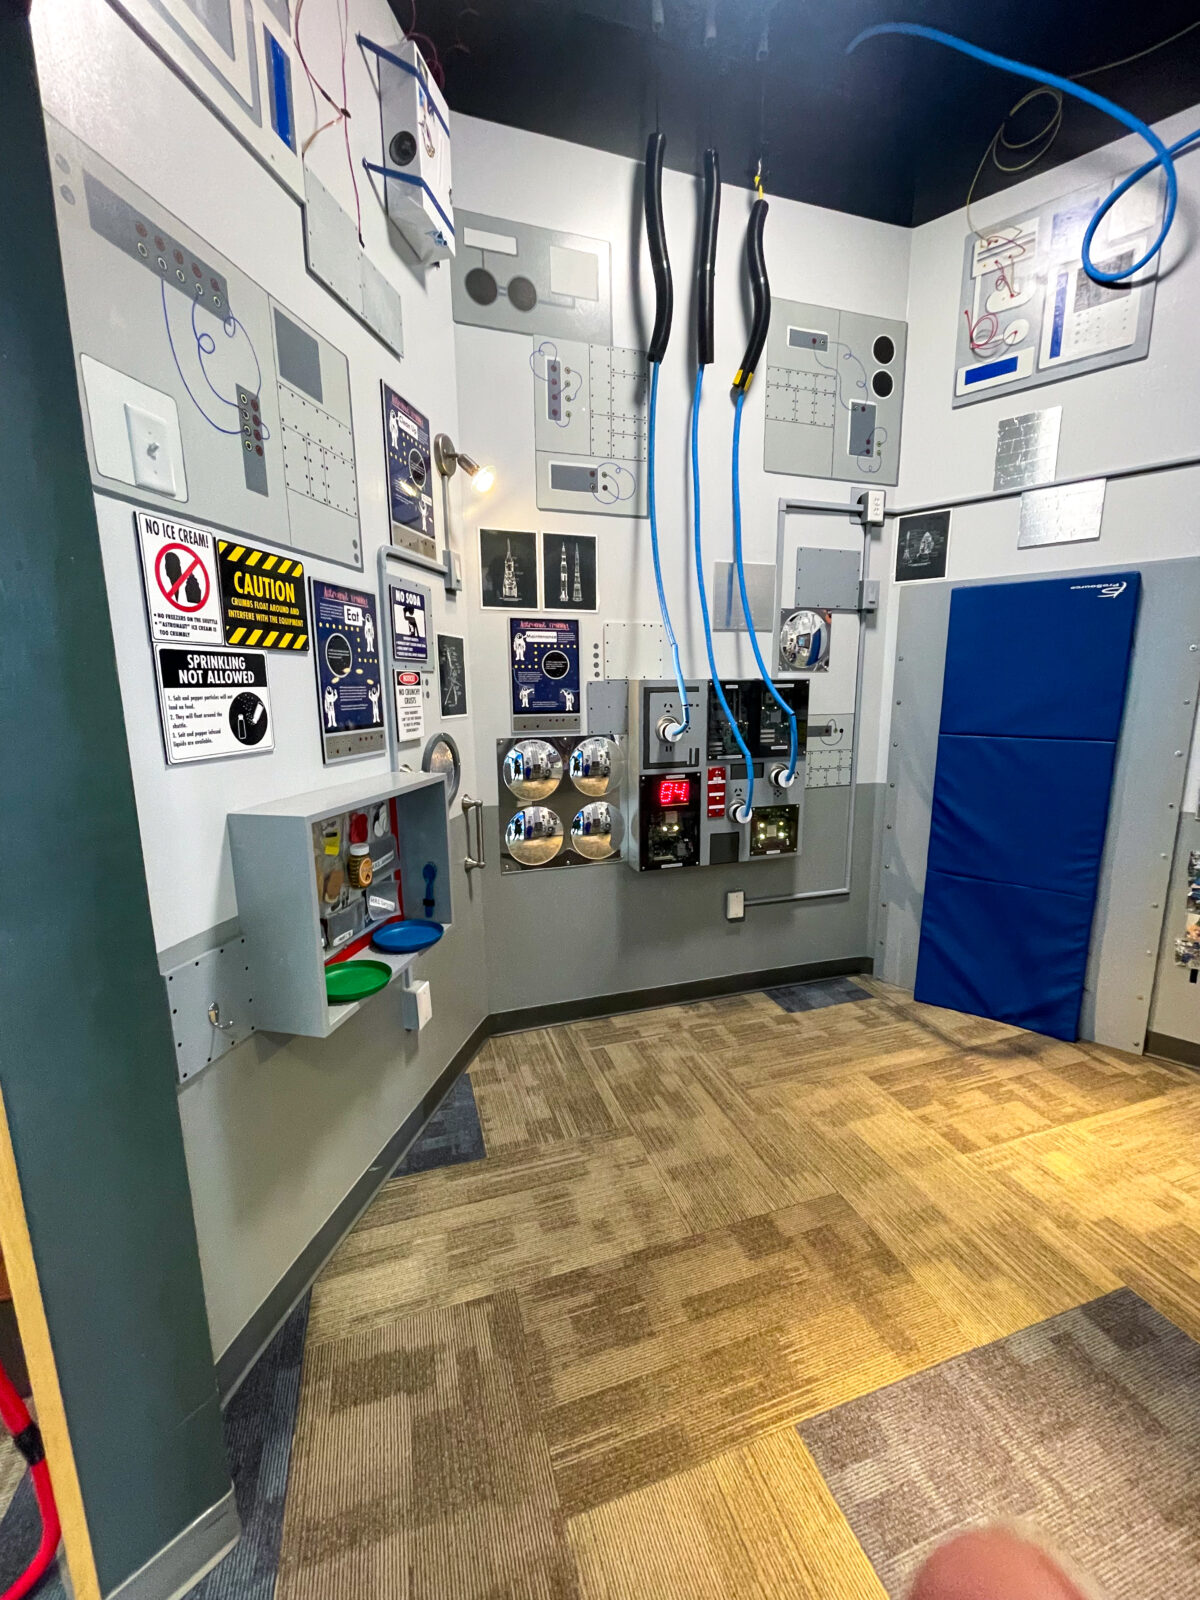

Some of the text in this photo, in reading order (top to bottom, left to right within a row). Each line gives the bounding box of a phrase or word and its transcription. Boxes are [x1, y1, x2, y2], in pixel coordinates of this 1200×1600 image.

[145, 518, 209, 548] NO ICE CREAM!
[234, 571, 295, 603] CAUTION
[231, 597, 299, 615] CRUMBS FLOAT AROUND AND
[395, 590, 421, 606] NO SODA
[228, 609, 303, 627] INTERFERE WITH THE EQUIPMENT
[347, 608, 360, 622] Eat
[187, 654, 246, 670] SPRINKLING
[178, 670, 254, 684] NOT ALLOWED
